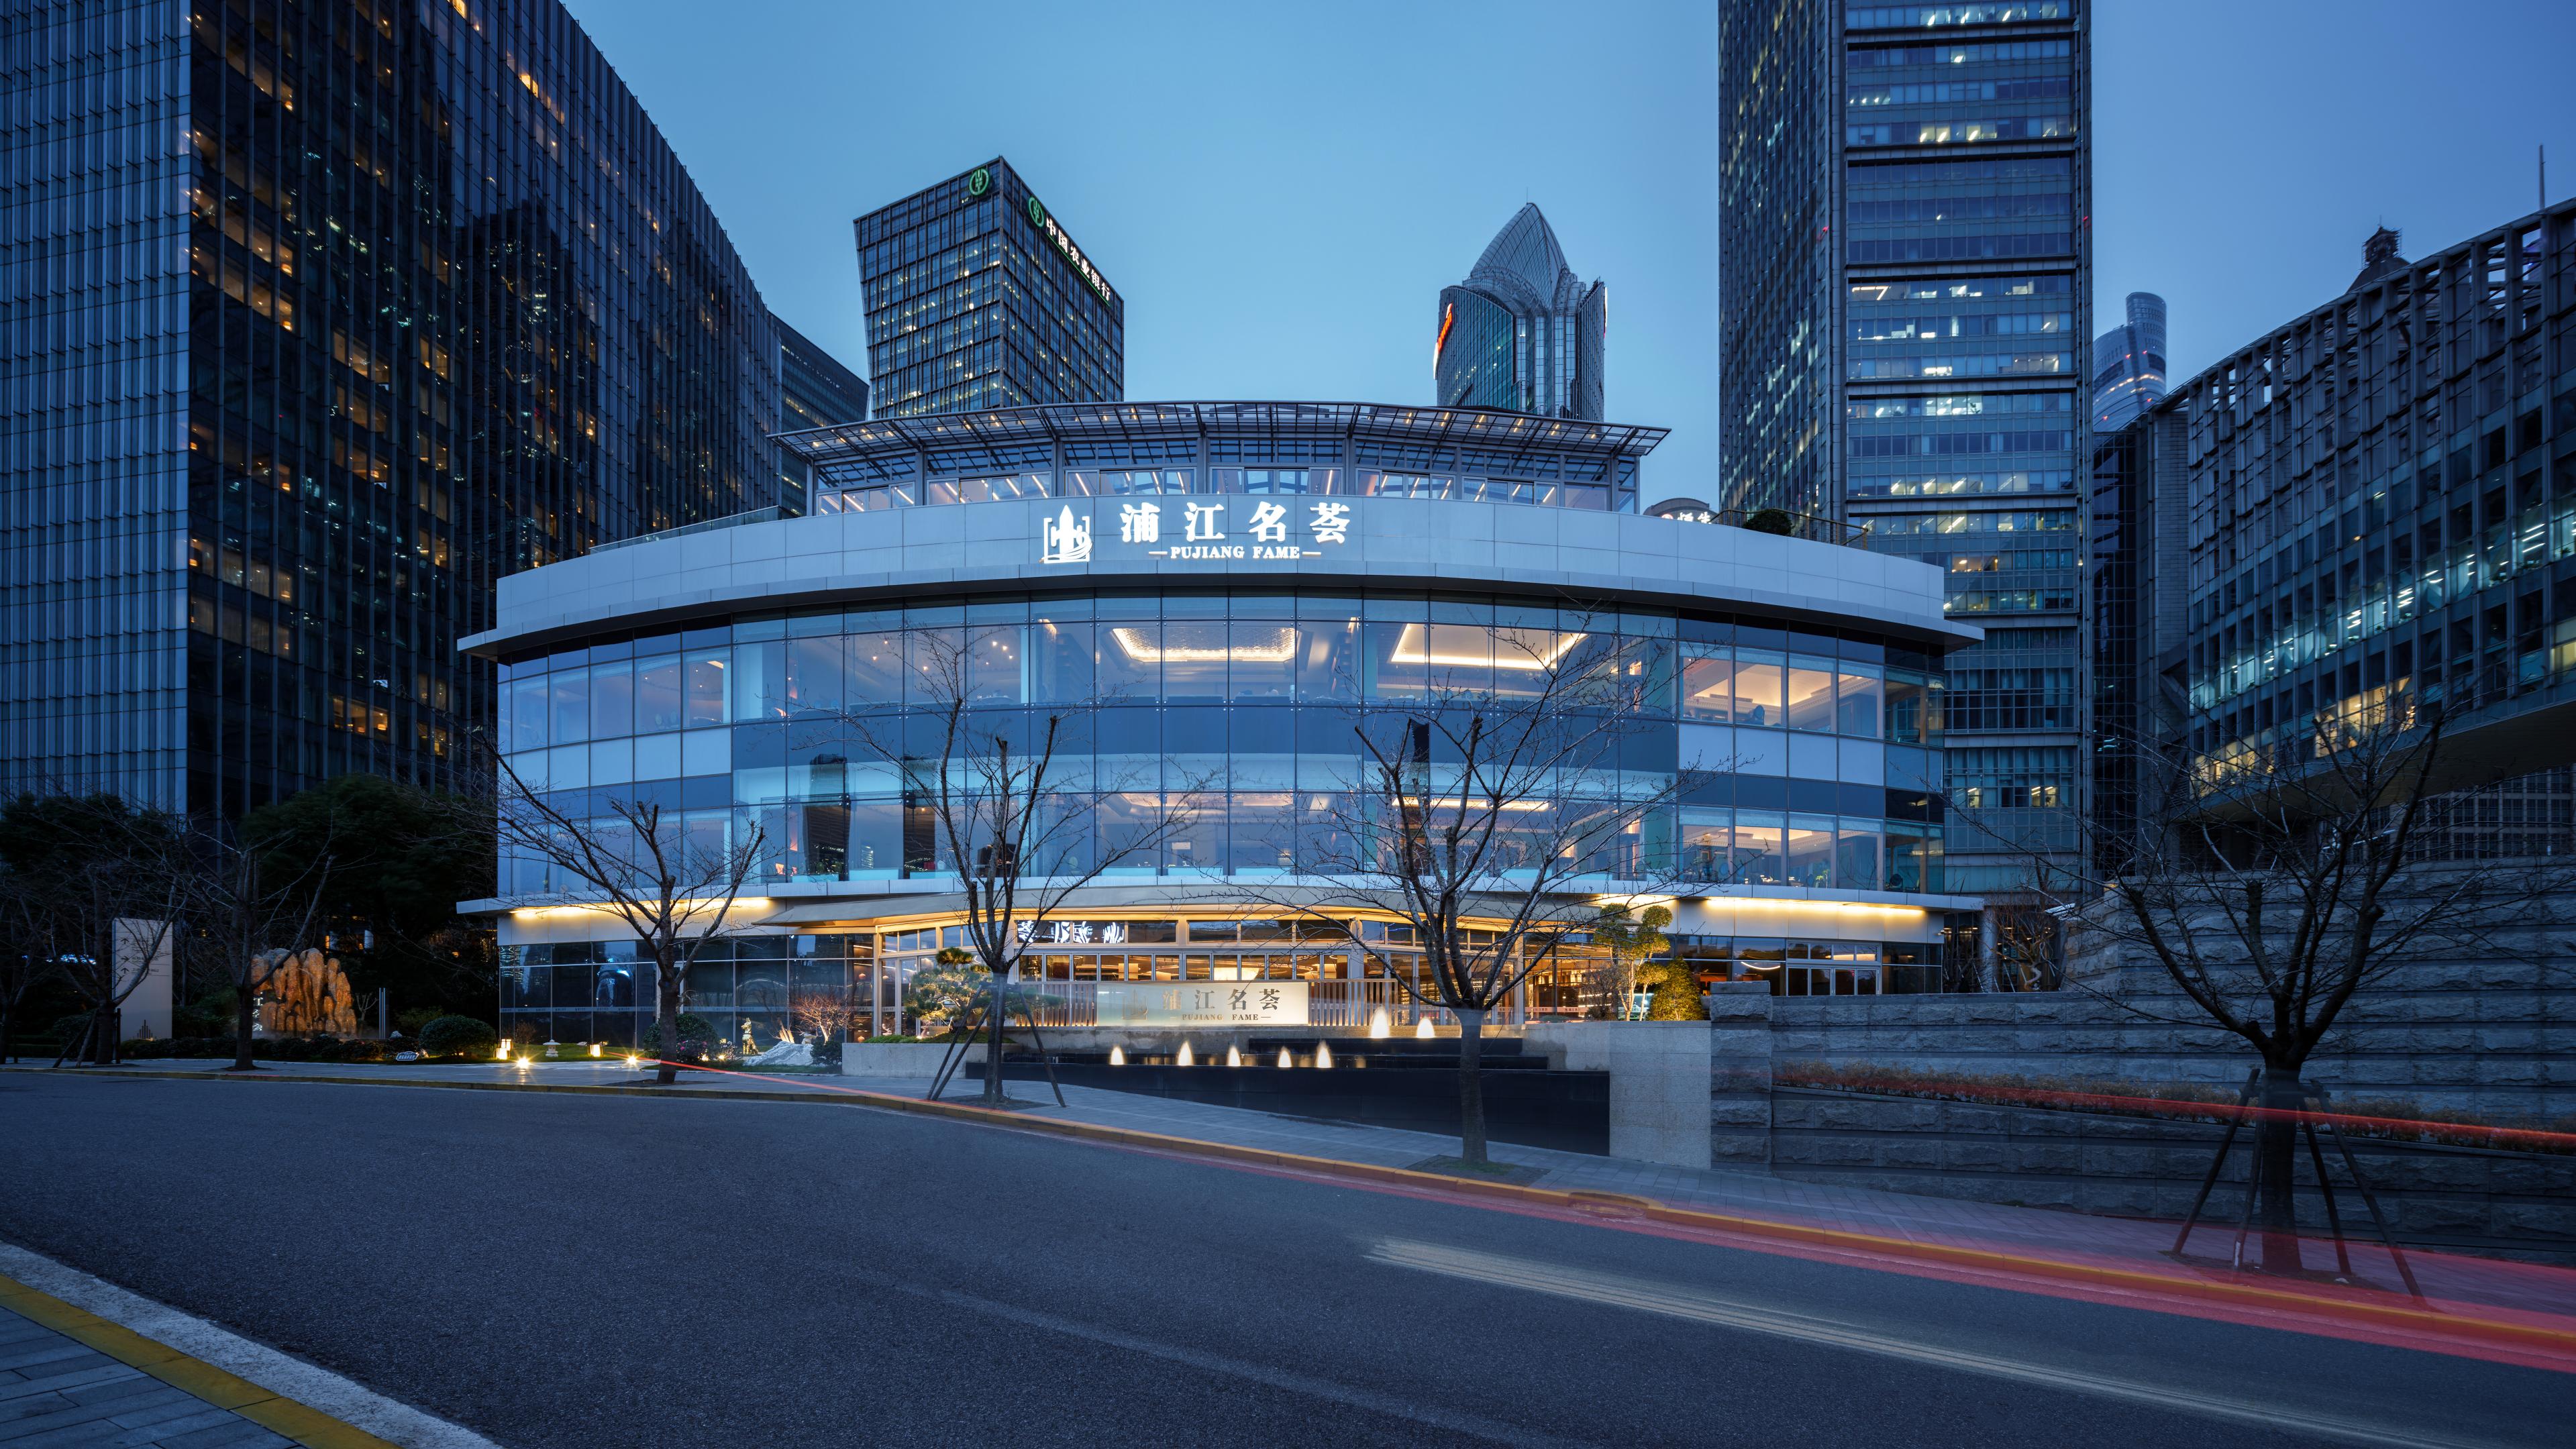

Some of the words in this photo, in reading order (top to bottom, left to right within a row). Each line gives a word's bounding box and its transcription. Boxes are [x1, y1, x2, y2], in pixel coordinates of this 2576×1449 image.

[1046, 218, 1111, 301] 中国农业银行
[1119, 501, 1350, 544] 浦江名荟
[1170, 546, 1245, 559] PUJIANG
[1253, 545, 1300, 559] FAME
[1162, 988, 1280, 1010] 浦江名荟
